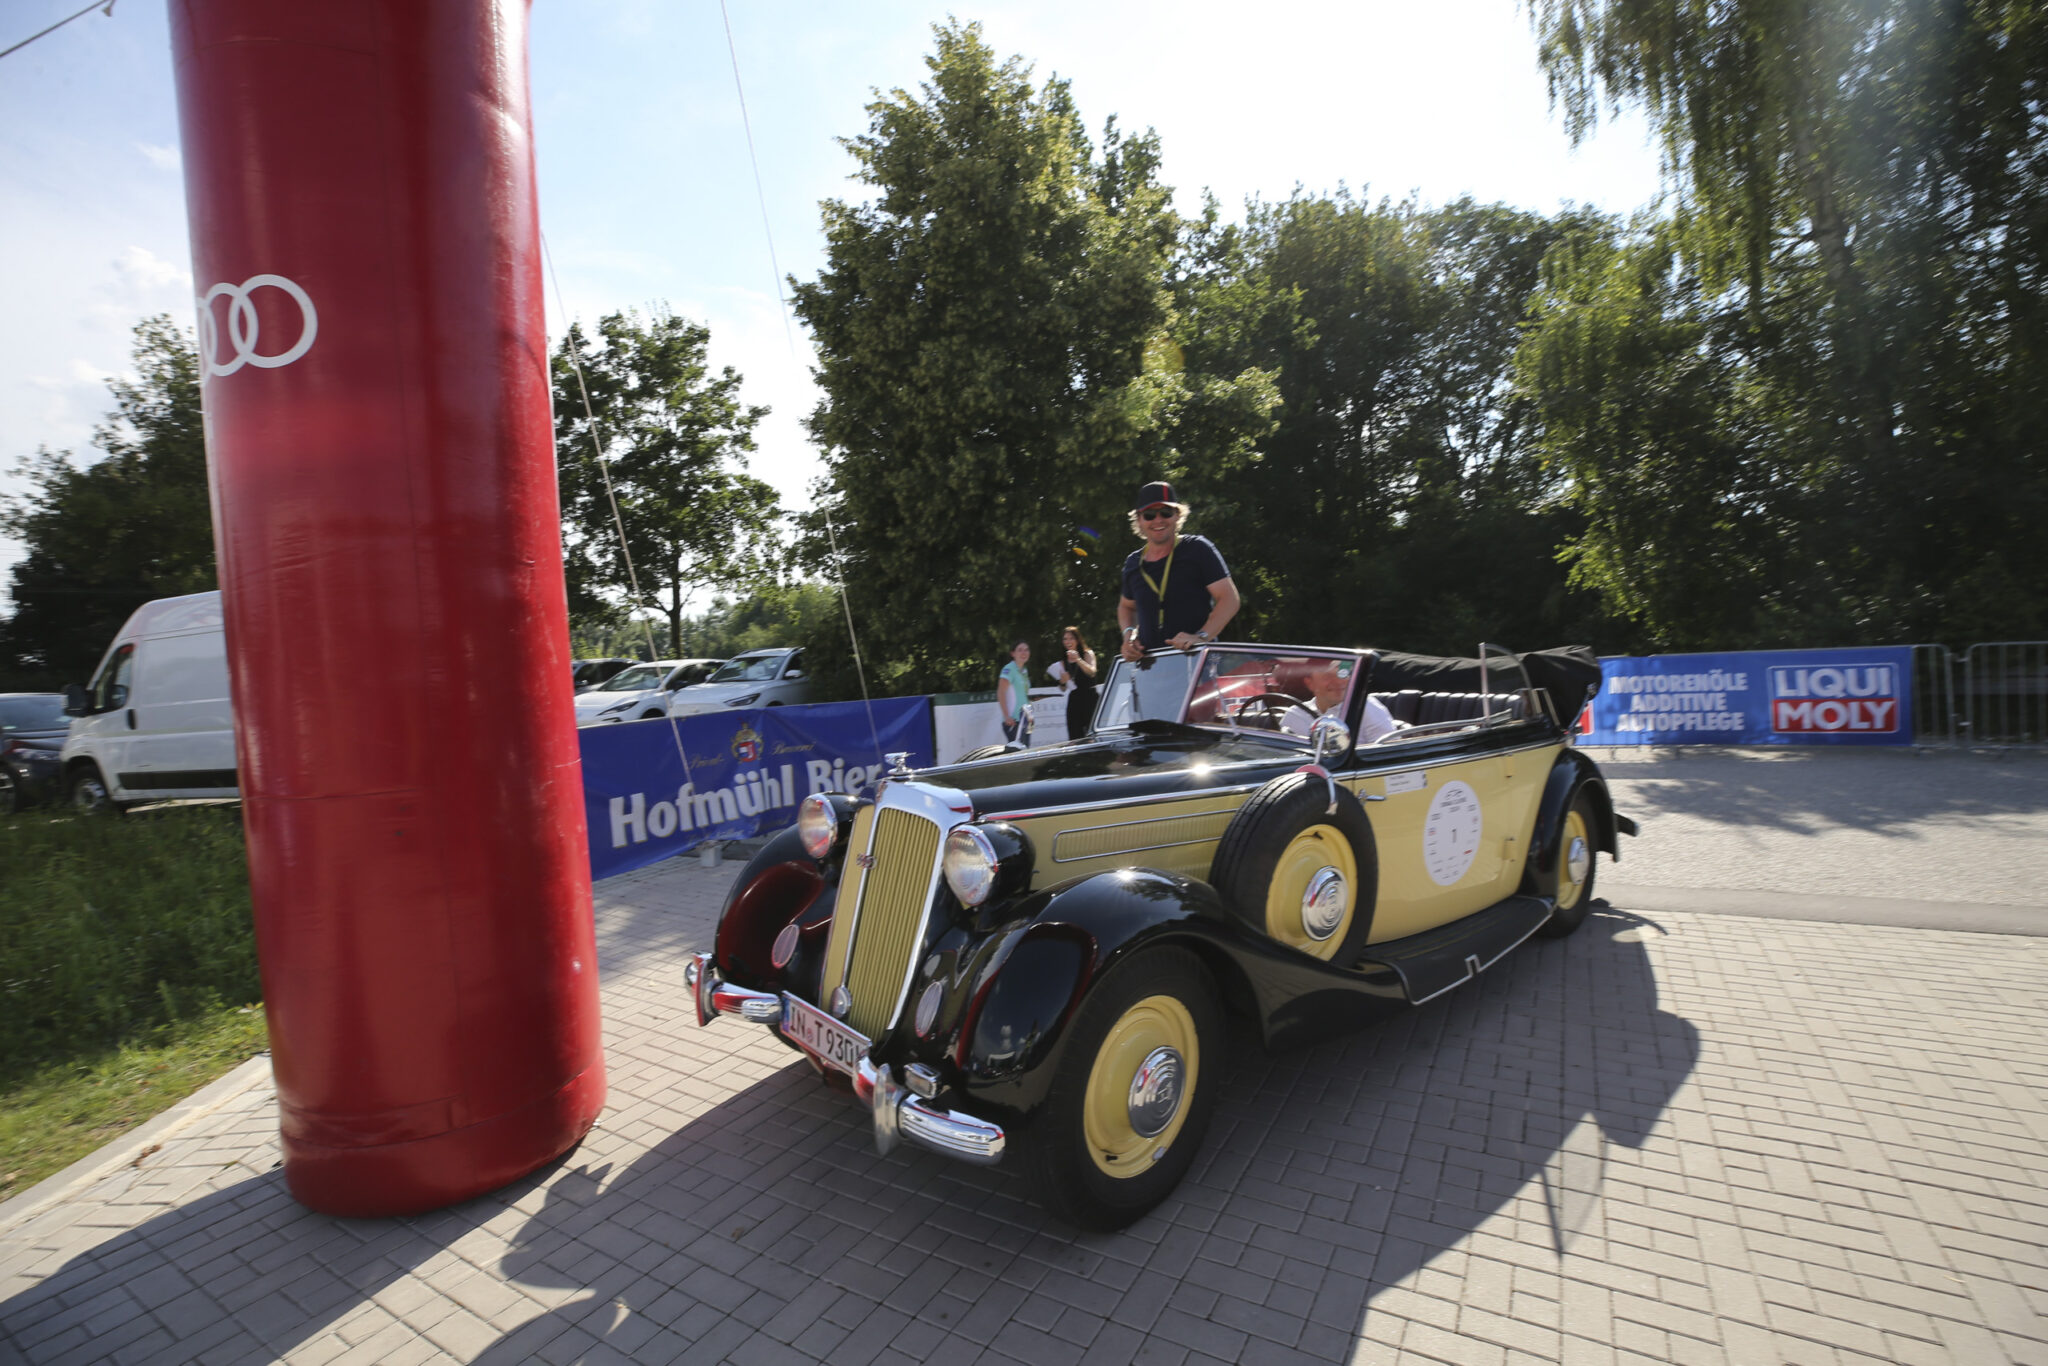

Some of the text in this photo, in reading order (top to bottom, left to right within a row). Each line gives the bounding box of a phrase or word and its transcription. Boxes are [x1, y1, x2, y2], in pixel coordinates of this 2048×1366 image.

[1608, 669, 1748, 694] MOTORENÖLE
[1774, 668, 1891, 698] LIQUI
[1630, 692, 1727, 712] ADDITIVE
[1777, 701, 1896, 730] MOLY
[1616, 711, 1744, 732] AUTOPFLEGE
[609, 764, 795, 848] Hofmühl
[806, 758, 882, 796] Bier
[790, 1006, 806, 1039] IN
[814, 1020, 823, 1048] T
